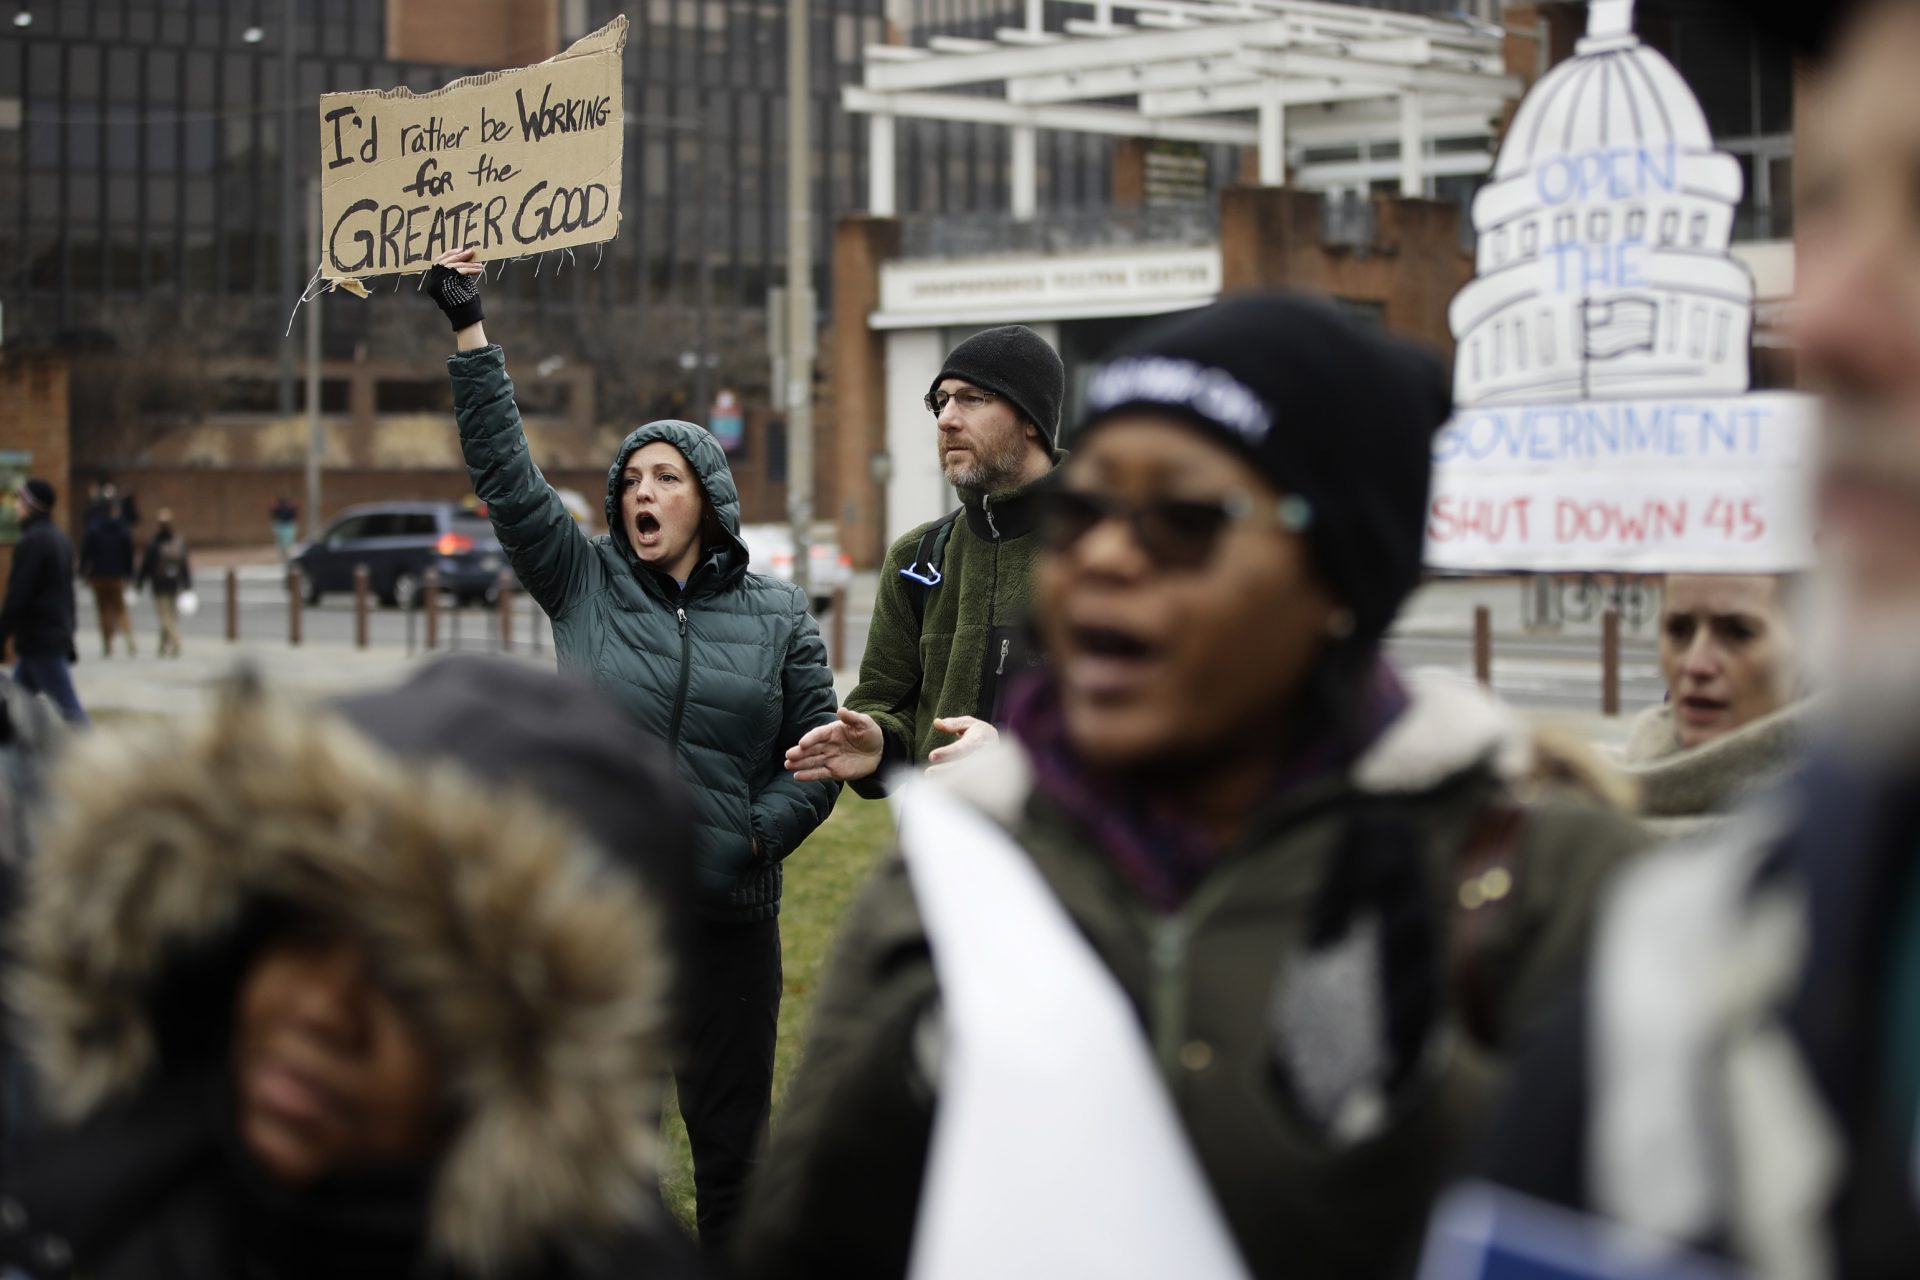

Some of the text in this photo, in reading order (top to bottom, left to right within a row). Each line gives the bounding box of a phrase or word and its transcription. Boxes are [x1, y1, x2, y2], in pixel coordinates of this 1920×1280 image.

[325, 83, 611, 169] I'd rather be WORKING
[468, 153, 521, 186] the
[1536, 143, 1676, 205] OPEN
[329, 180, 609, 273] GREATER GOOD
[1544, 240, 1648, 293] THE
[1428, 491, 1765, 543] SHUT DOWN 45
